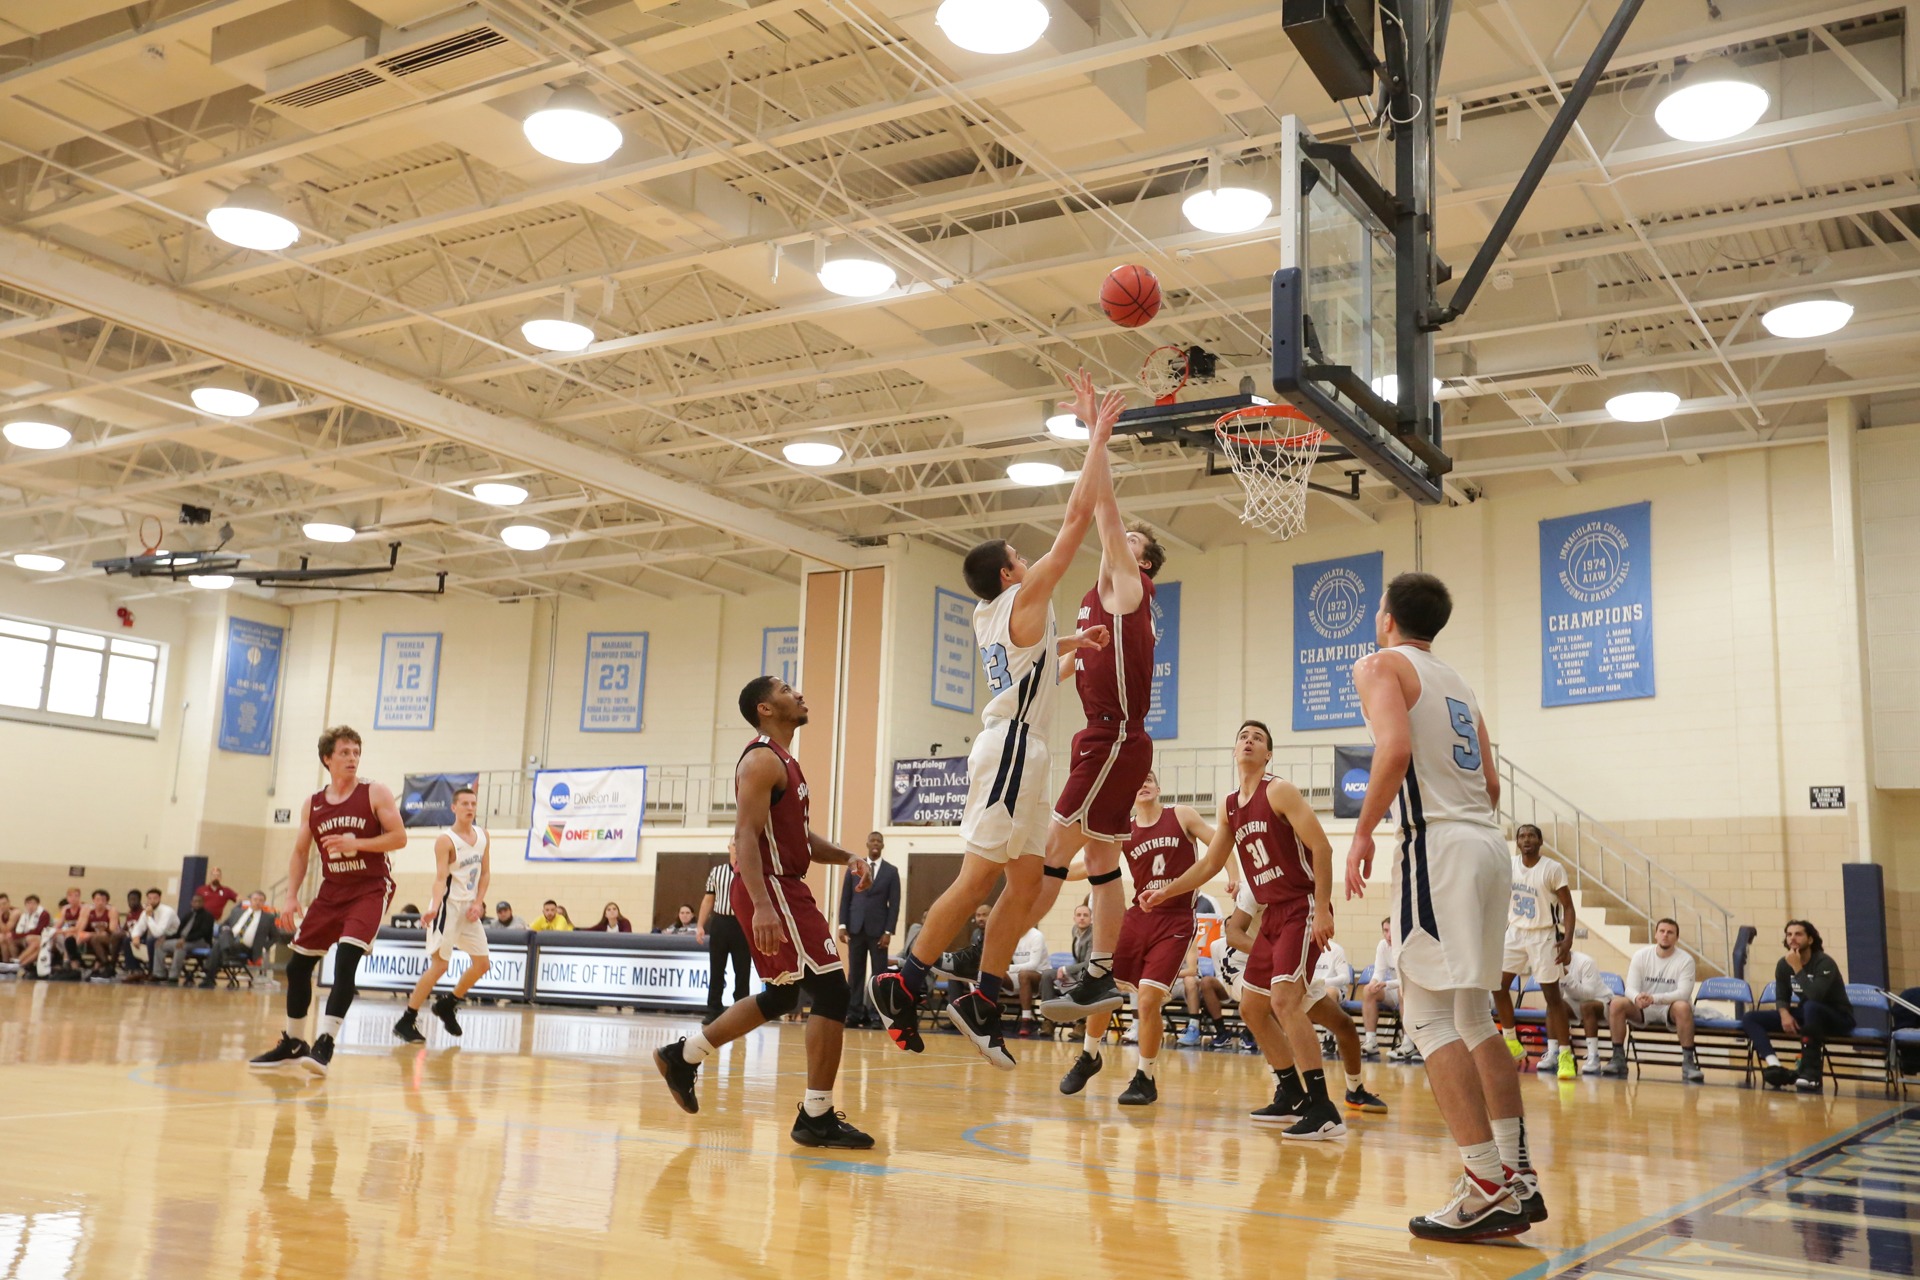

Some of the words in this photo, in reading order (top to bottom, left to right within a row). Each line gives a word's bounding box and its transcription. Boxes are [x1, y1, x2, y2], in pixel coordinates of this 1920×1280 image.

[1559, 521, 1602, 560] IMMACULATA
[1603, 522, 1629, 550] COLLEGE
[1583, 558, 1606, 571] 1974
[1309, 568, 1344, 601] IMMACULATA
[1345, 569, 1366, 594] COLLEGE
[1559, 570, 1589, 602] NATIONAL
[1590, 561, 1630, 602] BASKETBALL
[1582, 571, 1607, 583] AIAW
[1327, 600, 1346, 612] 1973
[1327, 611, 1347, 622] AIAW
[1549, 603, 1643, 632] CHAMPIONS
[1308, 610, 1332, 639] NATIONAL
[1333, 604, 1366, 639] BASKETBALL
[783, 636, 798, 644] MAR
[1300, 641, 1375, 664] CHAMPIONS
[395, 664, 421, 689] 12
[599, 664, 630, 690] 23
[1445, 697, 1481, 771] 5
[913, 761, 946, 769] Radiology
[913, 774, 941, 787] Penn
[943, 771, 970, 787] Med
[574, 792, 609, 805] Division
[918, 792, 945, 806] Valley
[946, 792, 968, 805] Forg
[914, 809, 964, 820] 610-576-75
[565, 829, 623, 841] ONETEAM
[1130, 836, 1179, 860] SOUTHERN
[1245, 838, 1270, 869] 30
[1152, 853, 1166, 877] 4
[467, 868, 478, 890] 3
[1513, 894, 1535, 919] 35
[364, 955, 432, 976] IMMACULA
[447, 958, 522, 981] UNIRSITY
[541, 963, 578, 983] HOME
[582, 964, 598, 983] OF
[604, 965, 628, 985] THE
[632, 966, 684, 987] MIGHTY
